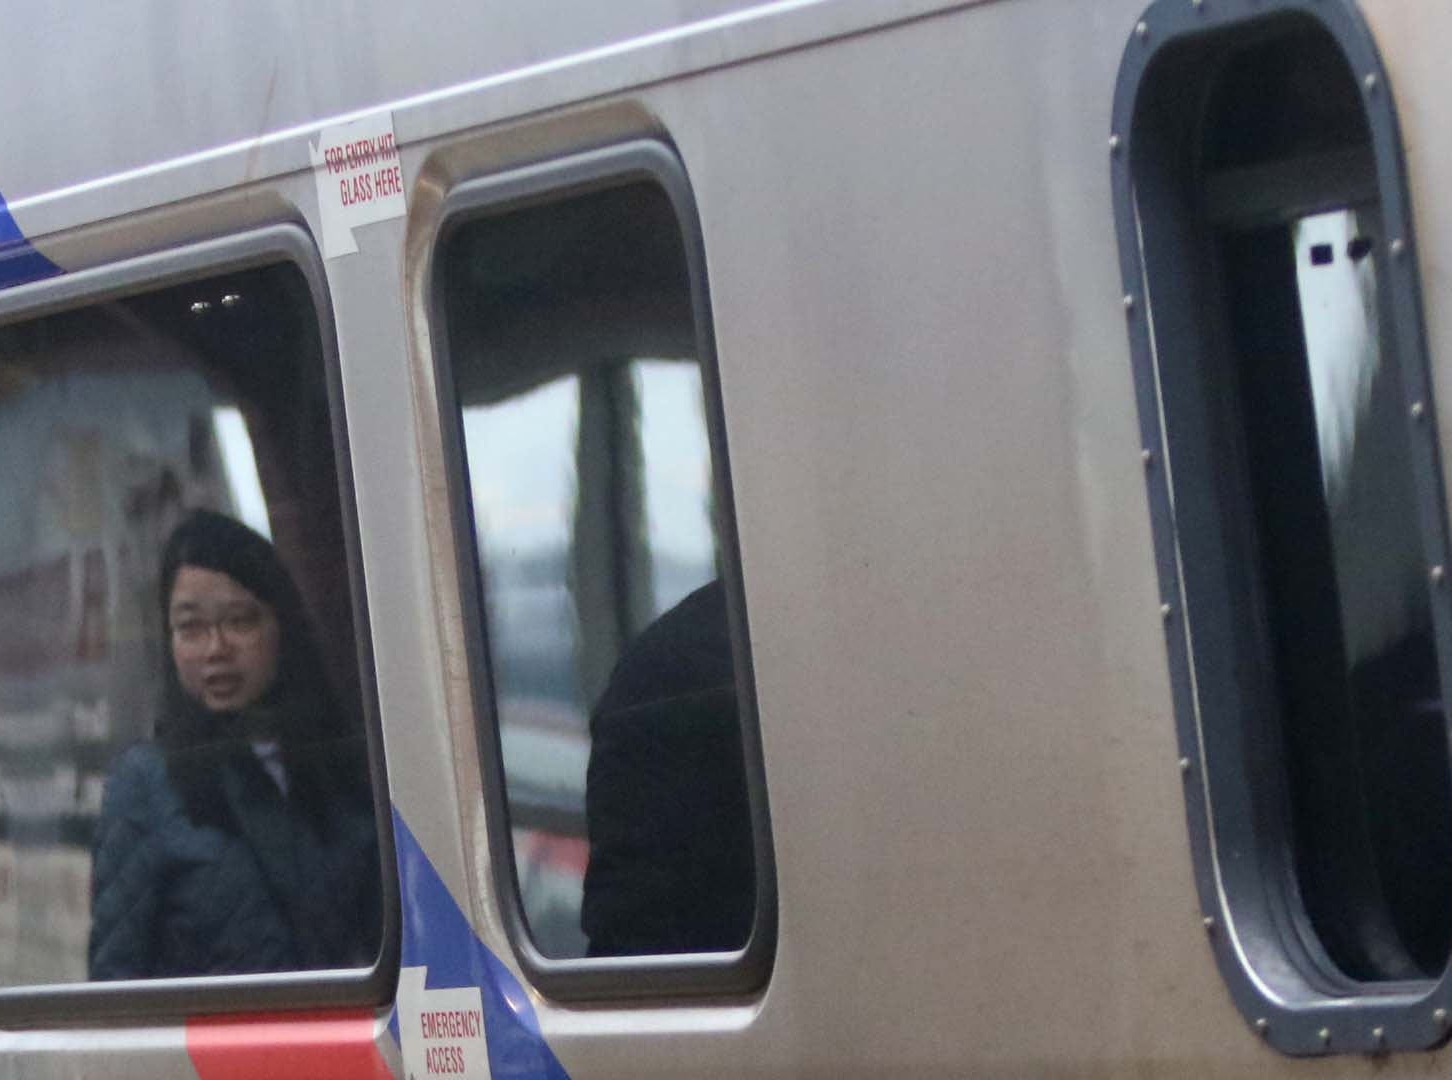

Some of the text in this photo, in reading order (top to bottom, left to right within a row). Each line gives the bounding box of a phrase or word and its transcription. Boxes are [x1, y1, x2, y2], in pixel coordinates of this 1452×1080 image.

[324, 133, 396, 174] FOR ENTRY HIT
[340, 166, 401, 206] GLASS HERE
[420, 1009, 481, 1039] EMERGENCY
[426, 1046, 465, 1074] ACCESS
